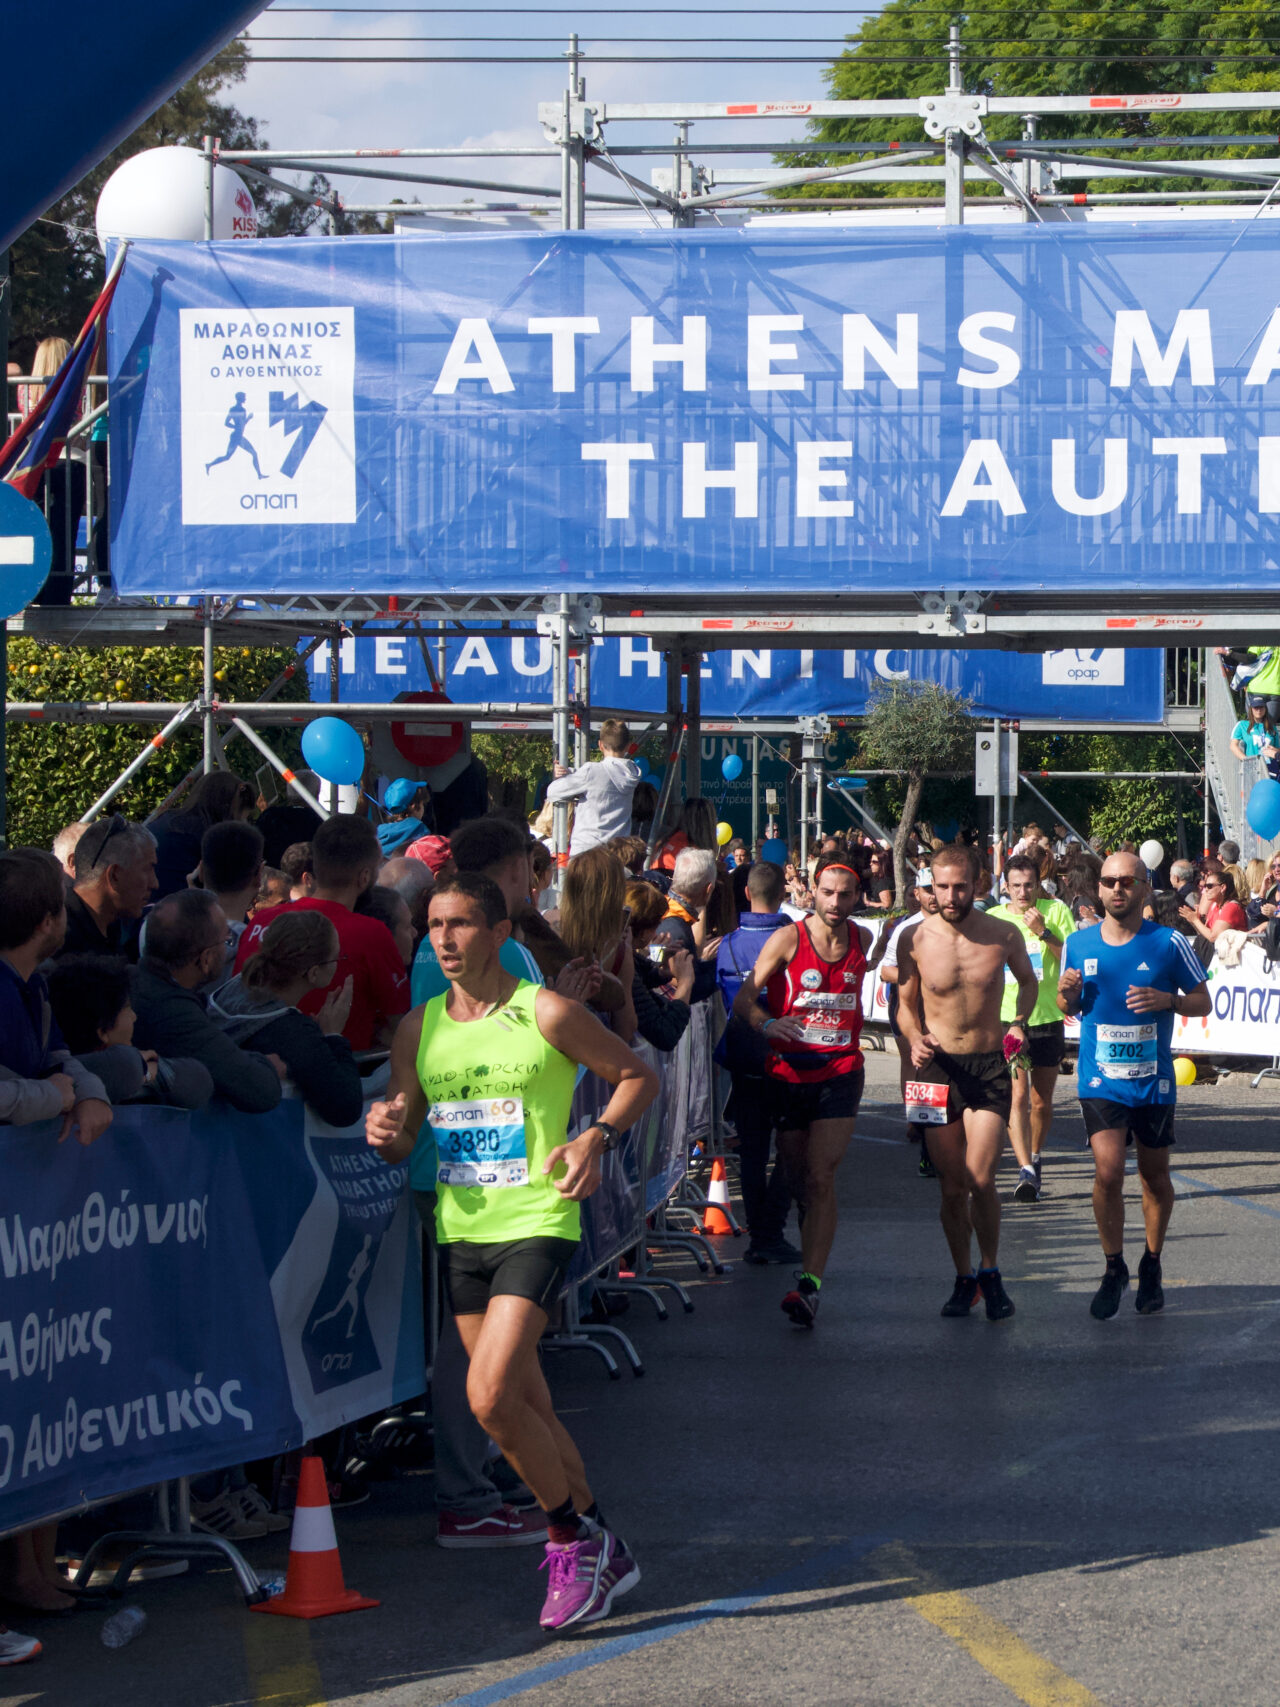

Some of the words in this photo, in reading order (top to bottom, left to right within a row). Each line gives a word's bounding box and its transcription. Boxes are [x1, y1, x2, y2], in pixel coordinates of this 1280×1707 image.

[193, 321, 342, 340] ΜΑΡΑΘΩΝΙΟΣ
[221, 343, 312, 361] ΑΘΗΝΑΣ
[434, 312, 1022, 395] ATHENS
[225, 365, 323, 378] ΑΥΘΕΝΤΙΚΟΣ
[581, 440, 854, 519] THE
[1067, 669, 1100, 681] opap
[1109, 1043, 1144, 1058] 3702
[905, 1084, 934, 1100] 5034
[448, 1128, 501, 1154] 3380
[22, 1371, 254, 1479] Αυθεντικός
